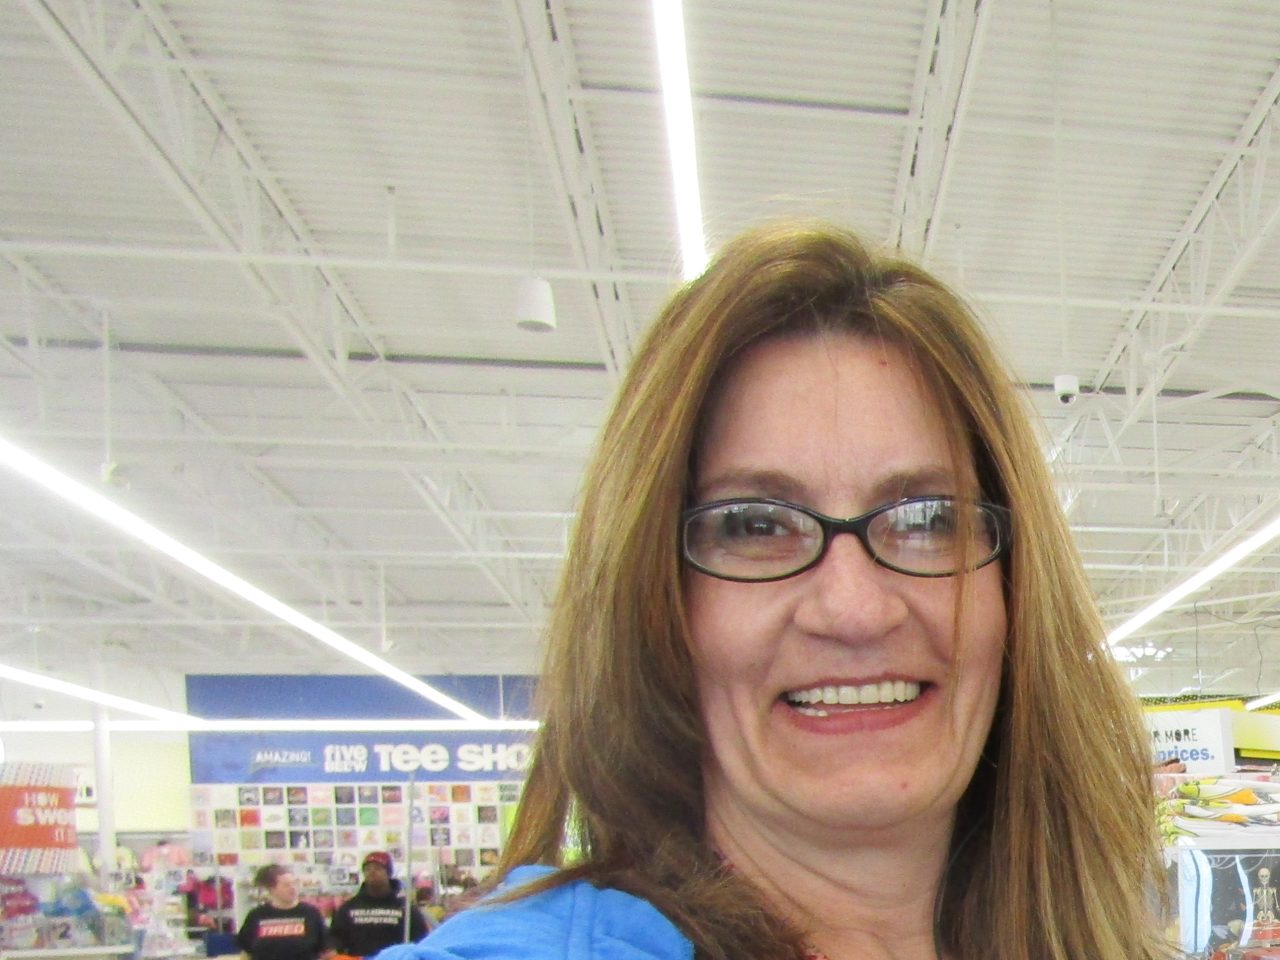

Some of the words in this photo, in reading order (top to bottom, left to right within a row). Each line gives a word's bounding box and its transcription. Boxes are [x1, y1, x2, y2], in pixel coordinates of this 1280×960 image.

[1165, 728, 1198, 742] MORE
[256, 750, 312, 764] AMAZING!
[324, 744, 368, 761] five
[457, 743, 531, 772] SHO
[1156, 746, 1215, 762] prices.
